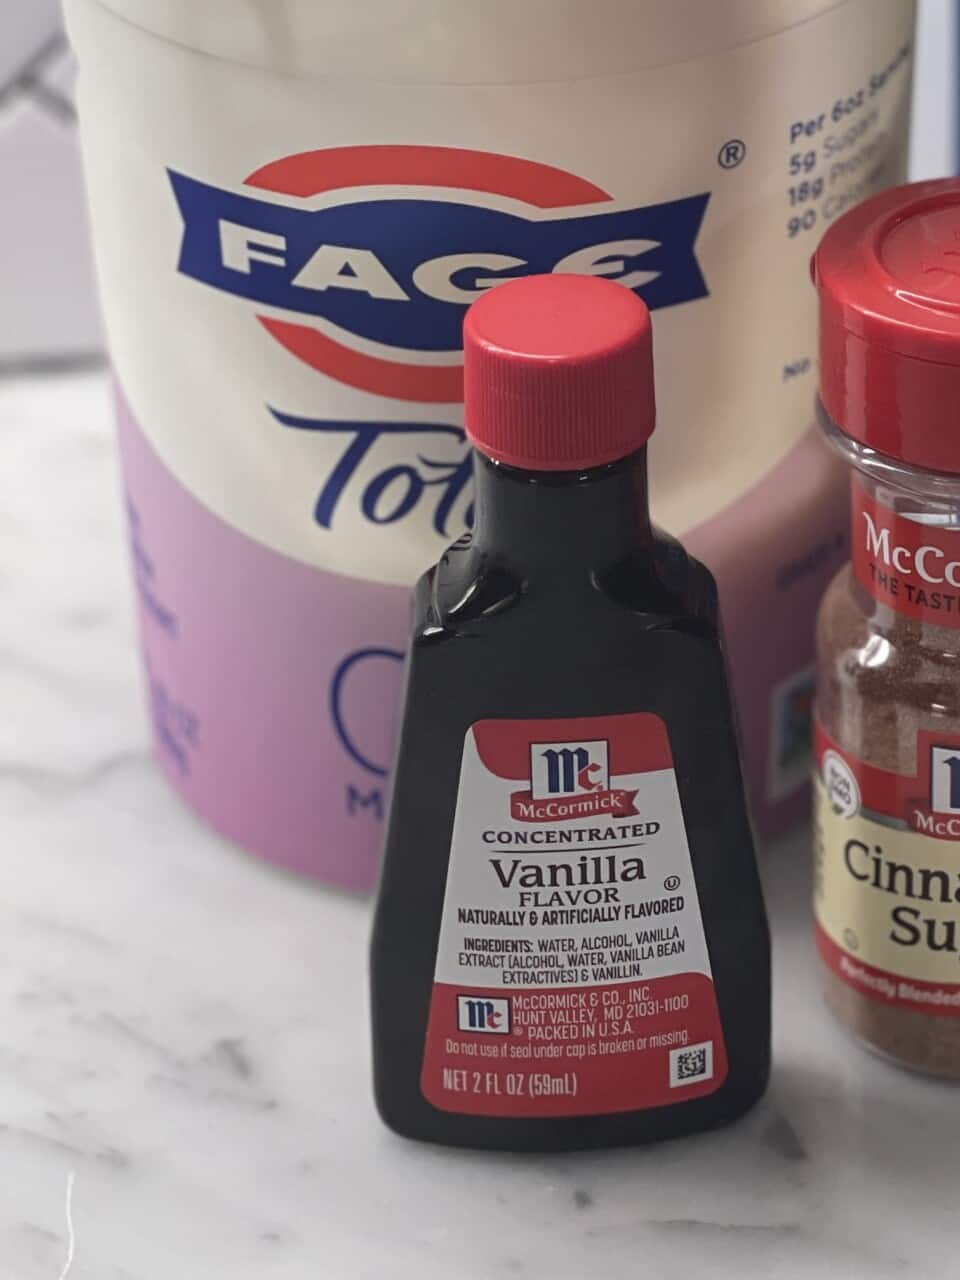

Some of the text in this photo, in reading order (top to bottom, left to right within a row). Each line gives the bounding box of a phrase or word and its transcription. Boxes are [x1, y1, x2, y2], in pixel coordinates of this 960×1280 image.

[789, 113, 826, 144] Per
[218, 217, 662, 303] FAGE
[265, 403, 475, 538] Tot
[870, 564, 899, 596] THE
[516, 792, 622, 819] McCormick
[482, 821, 661, 844] CONCENTRATED
[489, 855, 646, 889] Vanilla
[457, 907, 526, 927] NATURALLY
[542, 905, 621, 926] ARTIFICIALLY
[624, 896, 684, 920] FLAVORED
[518, 887, 621, 908] FLAVOR
[463, 926, 680, 953] INGREDIENTS: WATER, ALCOHOL, VANILLA
[458, 953, 505, 969] EXTRACT
[567, 952, 607, 969] WATER,
[609, 947, 655, 965] VANILLA
[657, 940, 686, 958] BEAN
[591, 964, 643, 983] VANILLIN.
[512, 1010, 545, 1025] HUNT
[603, 1006, 624, 1021] MD
[626, 995, 690, 1017] 21031-1100
[527, 1025, 579, 1041] PACKED
[582, 1023, 596, 1039] IN
[445, 1038, 460, 1055] Do
[461, 1041, 478, 1057] not
[480, 1044, 498, 1058] use
[510, 1041, 532, 1059] seal
[533, 1042, 563, 1059] under
[566, 1043, 586, 1060] cap
[587, 1041, 597, 1056] is
[599, 1037, 635, 1056] broken
[637, 1035, 648, 1050] or
[443, 1068, 578, 1099] NET 2 FL OZ (59mL)
